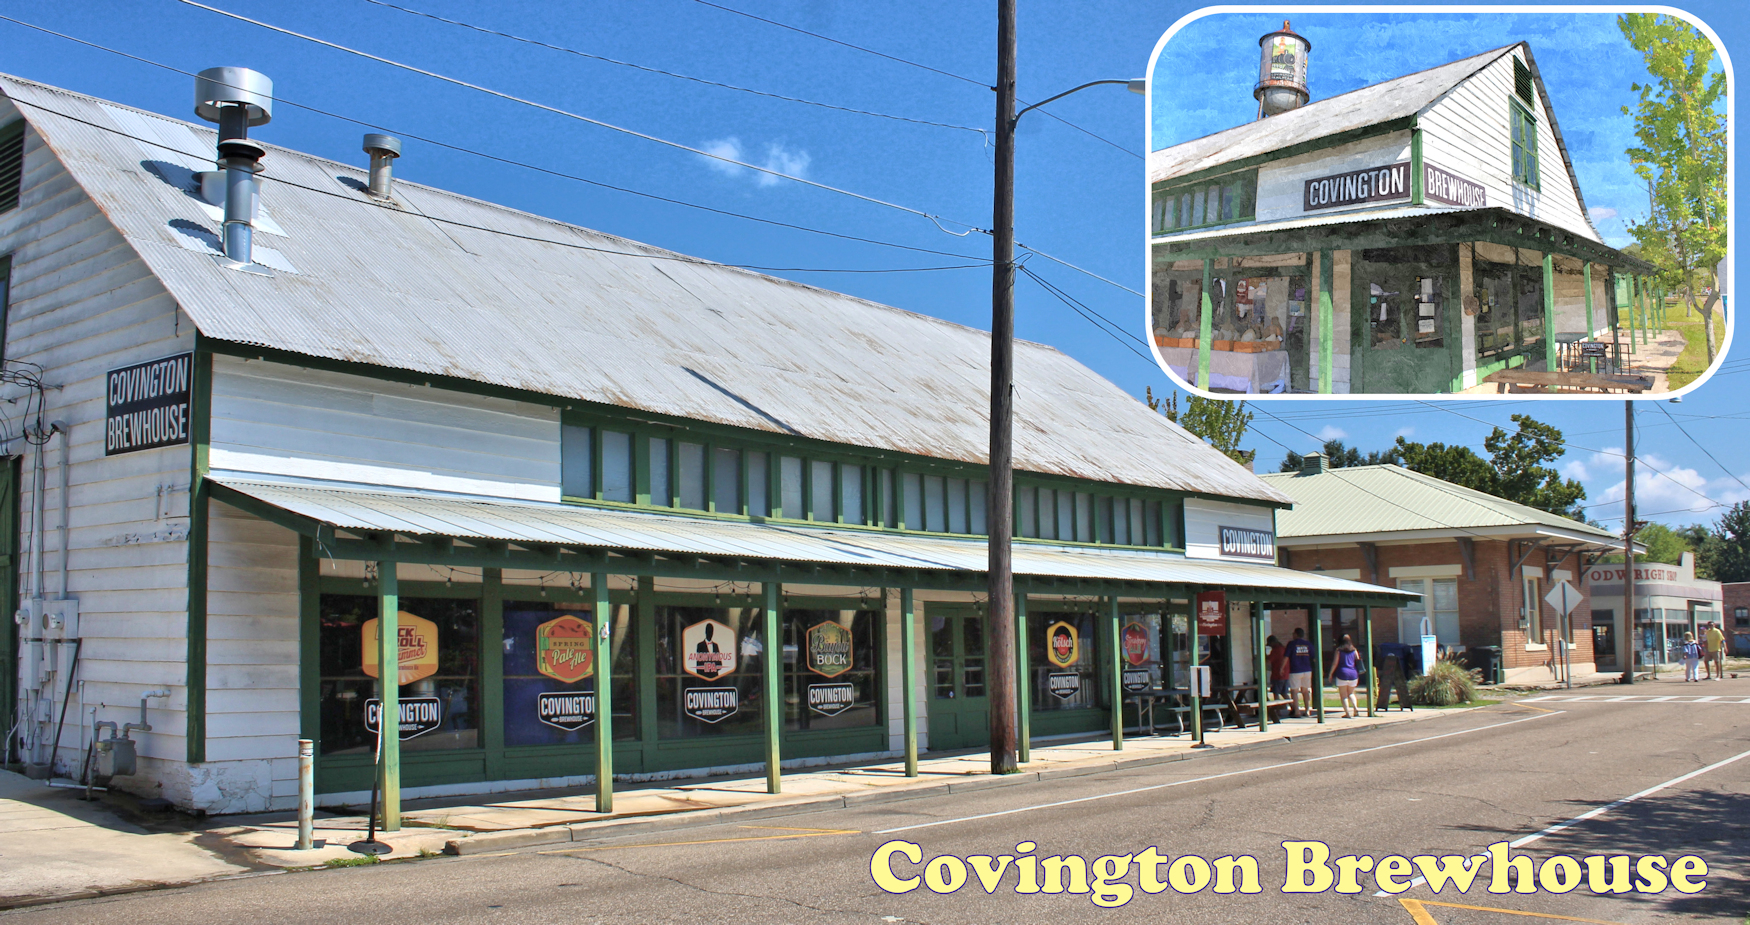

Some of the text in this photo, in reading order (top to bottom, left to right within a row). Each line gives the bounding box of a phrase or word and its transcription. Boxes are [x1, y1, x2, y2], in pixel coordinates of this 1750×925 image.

[1309, 166, 1404, 206] COVINGTON
[1427, 167, 1485, 206] BREWHOUSE
[109, 357, 188, 406] COVINGTON
[108, 403, 187, 450] BREWHOUSE
[1223, 529, 1273, 556] COVINGTON
[1667, 570, 1677, 581] SHOP
[398, 638, 424, 647] OLL
[552, 648, 586, 670] Pale Ale
[688, 652, 732, 661] ANONYMOUS
[817, 654, 846, 665] BOCK
[704, 662, 717, 672] IPA
[1050, 676, 1079, 689] COVINGTON
[1123, 672, 1149, 684] COVINGTON
[687, 691, 736, 709] COVINGTON
[810, 687, 852, 704] COVINGTON
[368, 703, 438, 724] CNGTON
